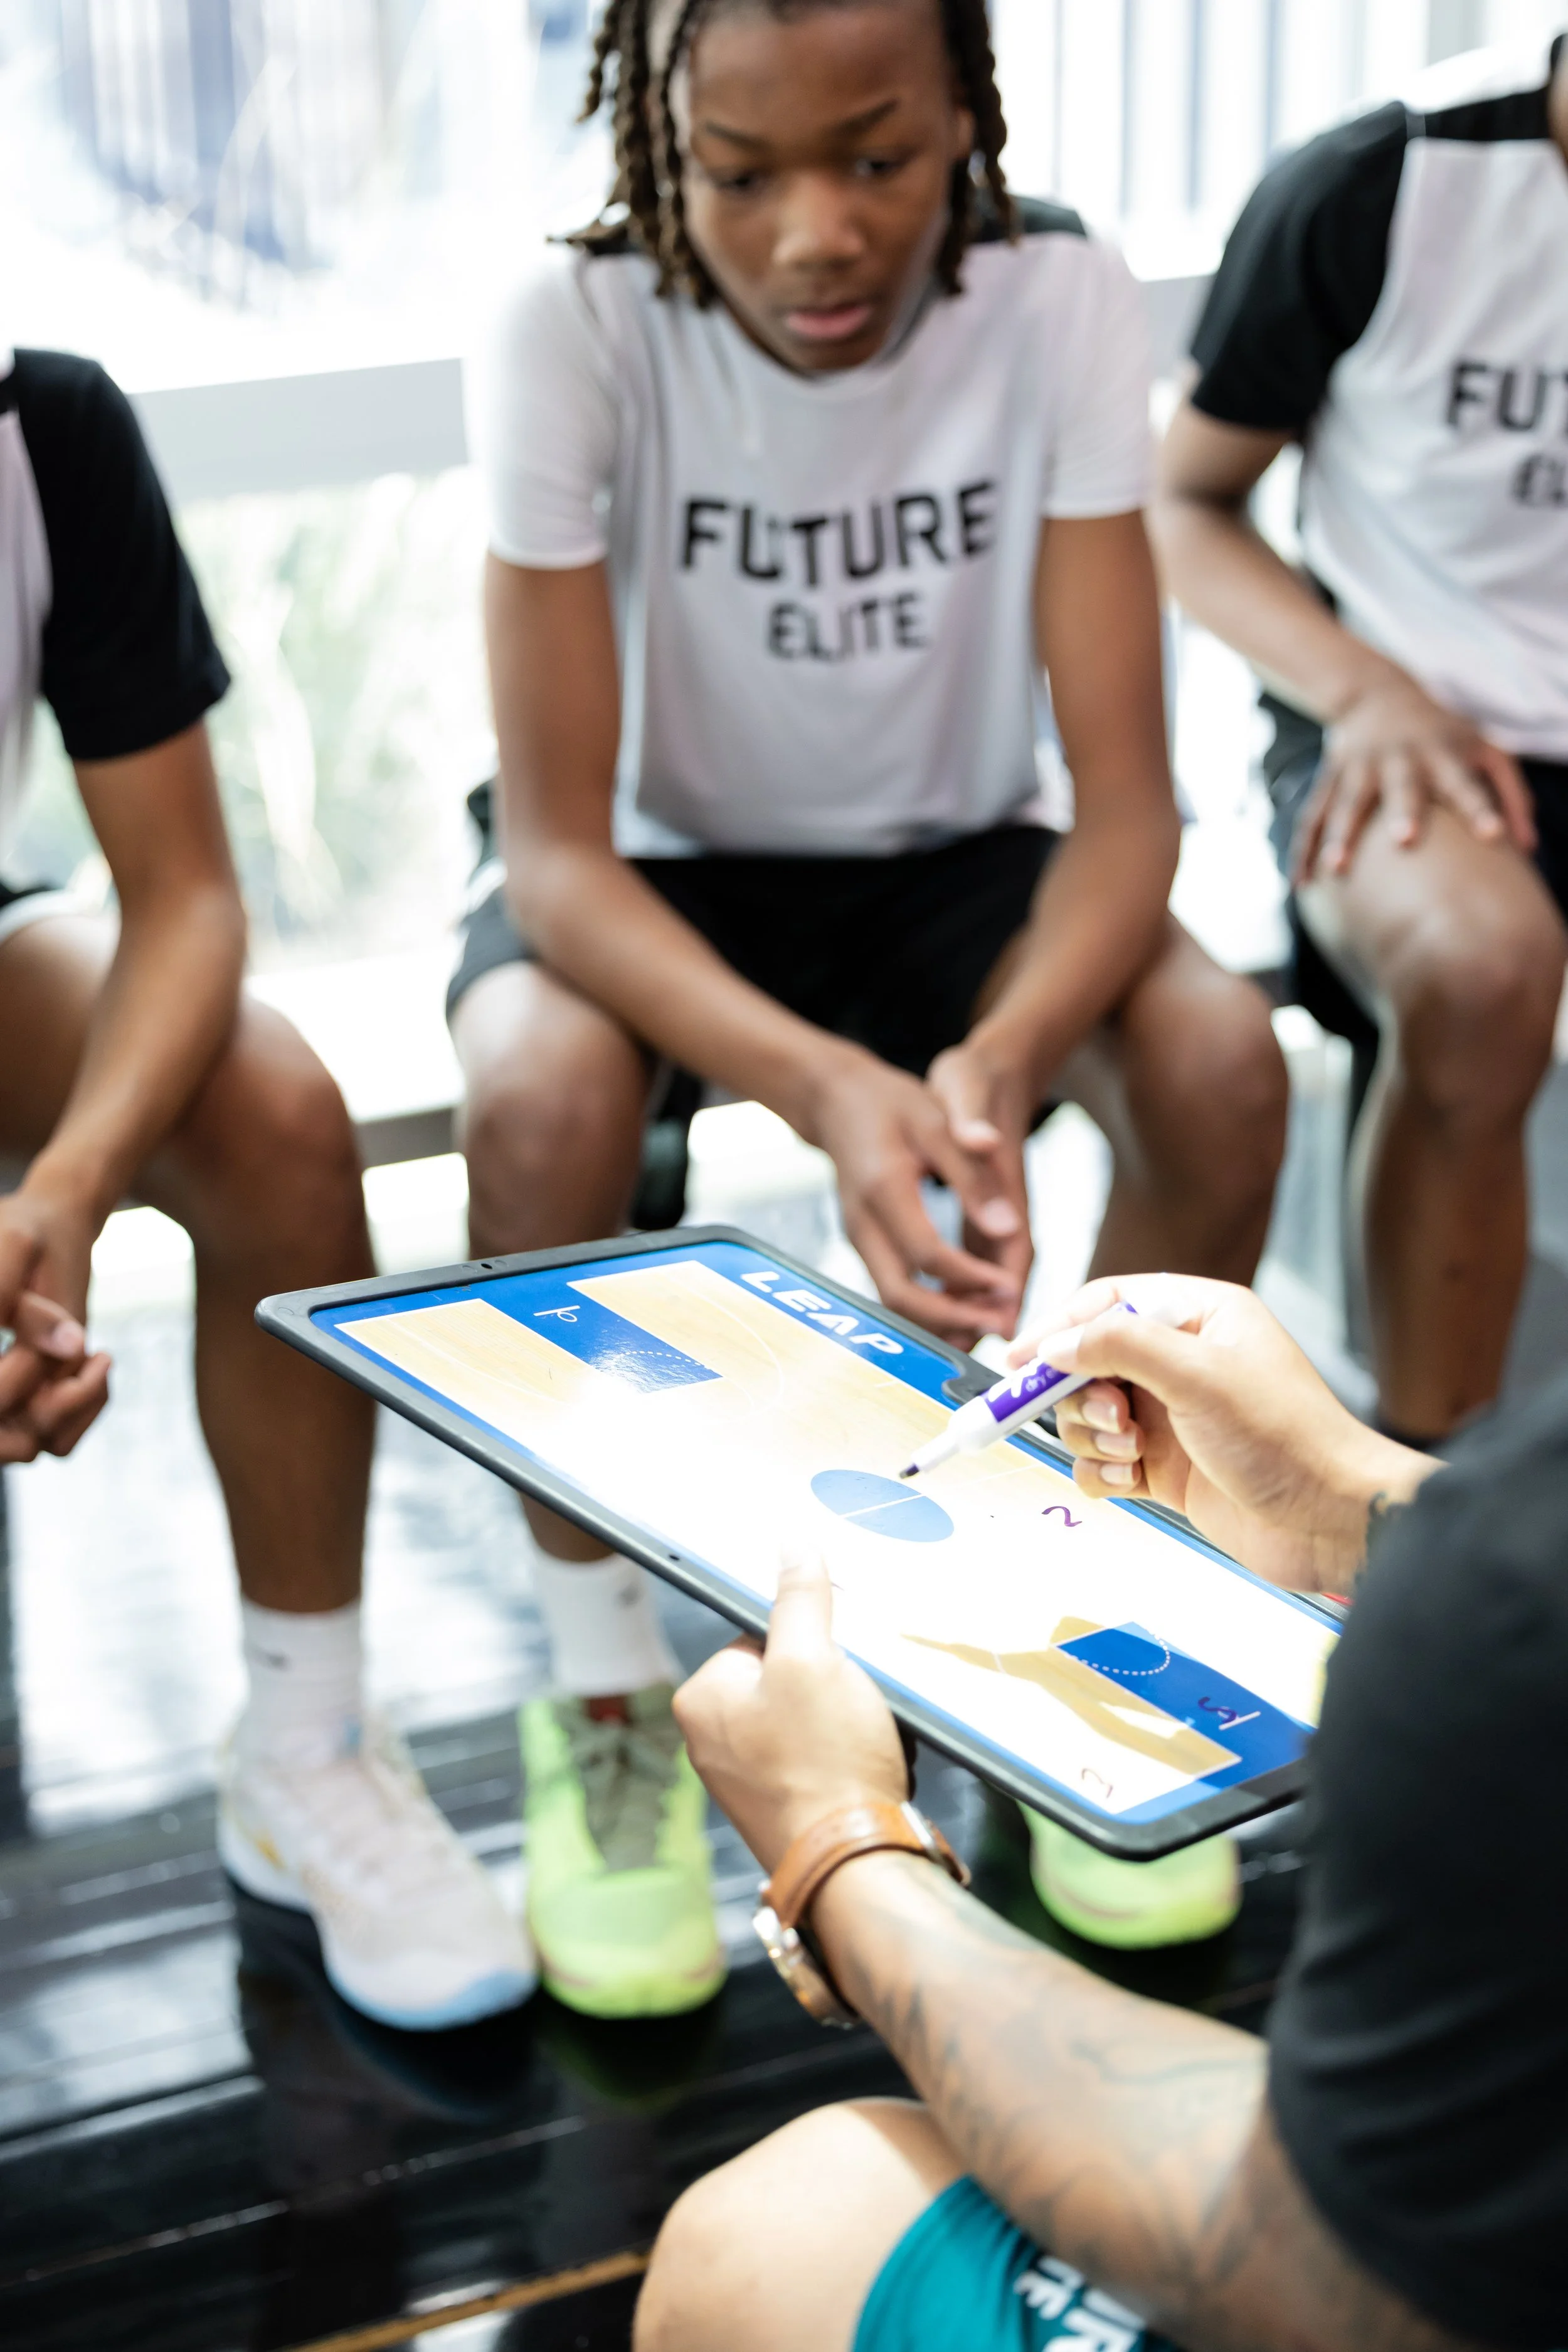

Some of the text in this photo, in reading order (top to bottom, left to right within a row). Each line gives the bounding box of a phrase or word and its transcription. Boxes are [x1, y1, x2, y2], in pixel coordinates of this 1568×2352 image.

[1445, 359, 1568, 440] FU
[681, 479, 995, 588] FUTURE
[768, 592, 932, 662] ELITE
[740, 1271, 904, 1355] LEAP
